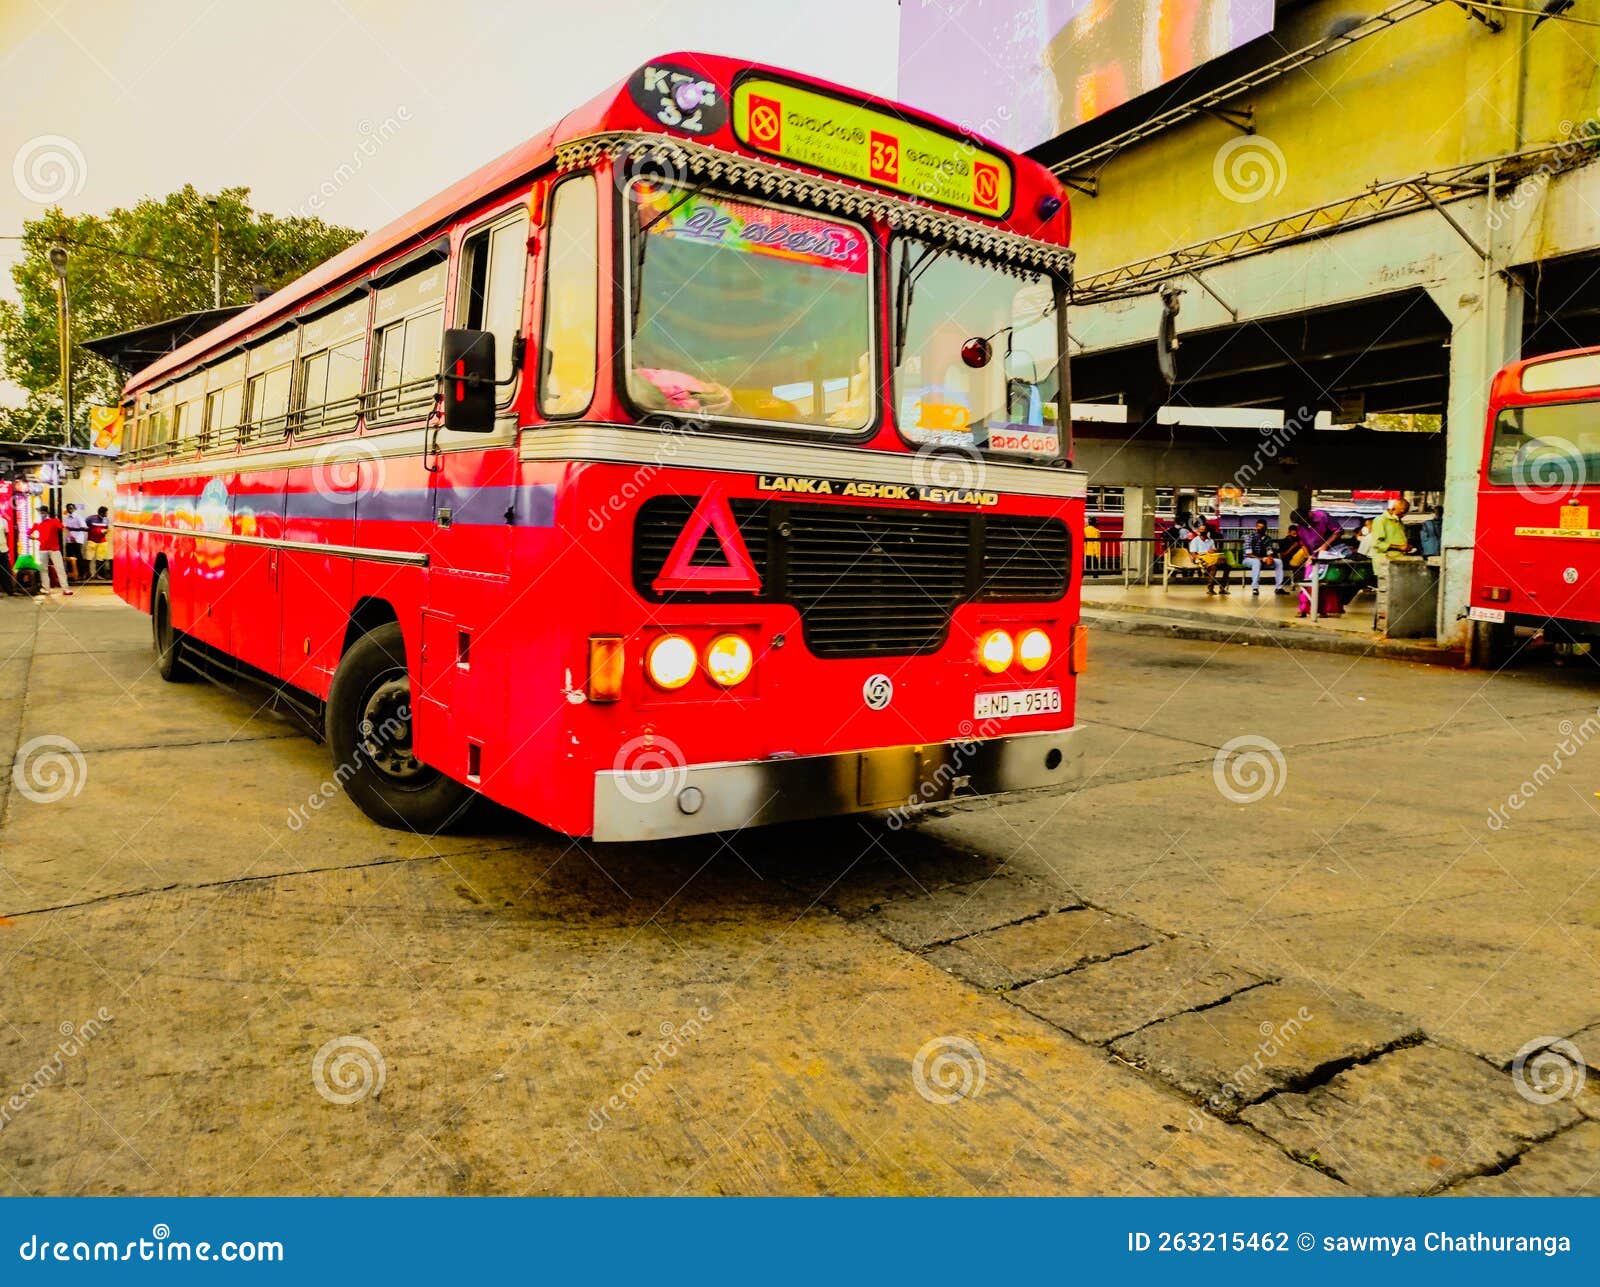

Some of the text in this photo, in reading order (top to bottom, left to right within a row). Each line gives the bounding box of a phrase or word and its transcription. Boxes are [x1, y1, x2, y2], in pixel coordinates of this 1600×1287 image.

[870, 140, 898, 176] 32
[990, 433, 1058, 452] කතරගම
[758, 475, 999, 506] LANKA ASHOK LEYLAND
